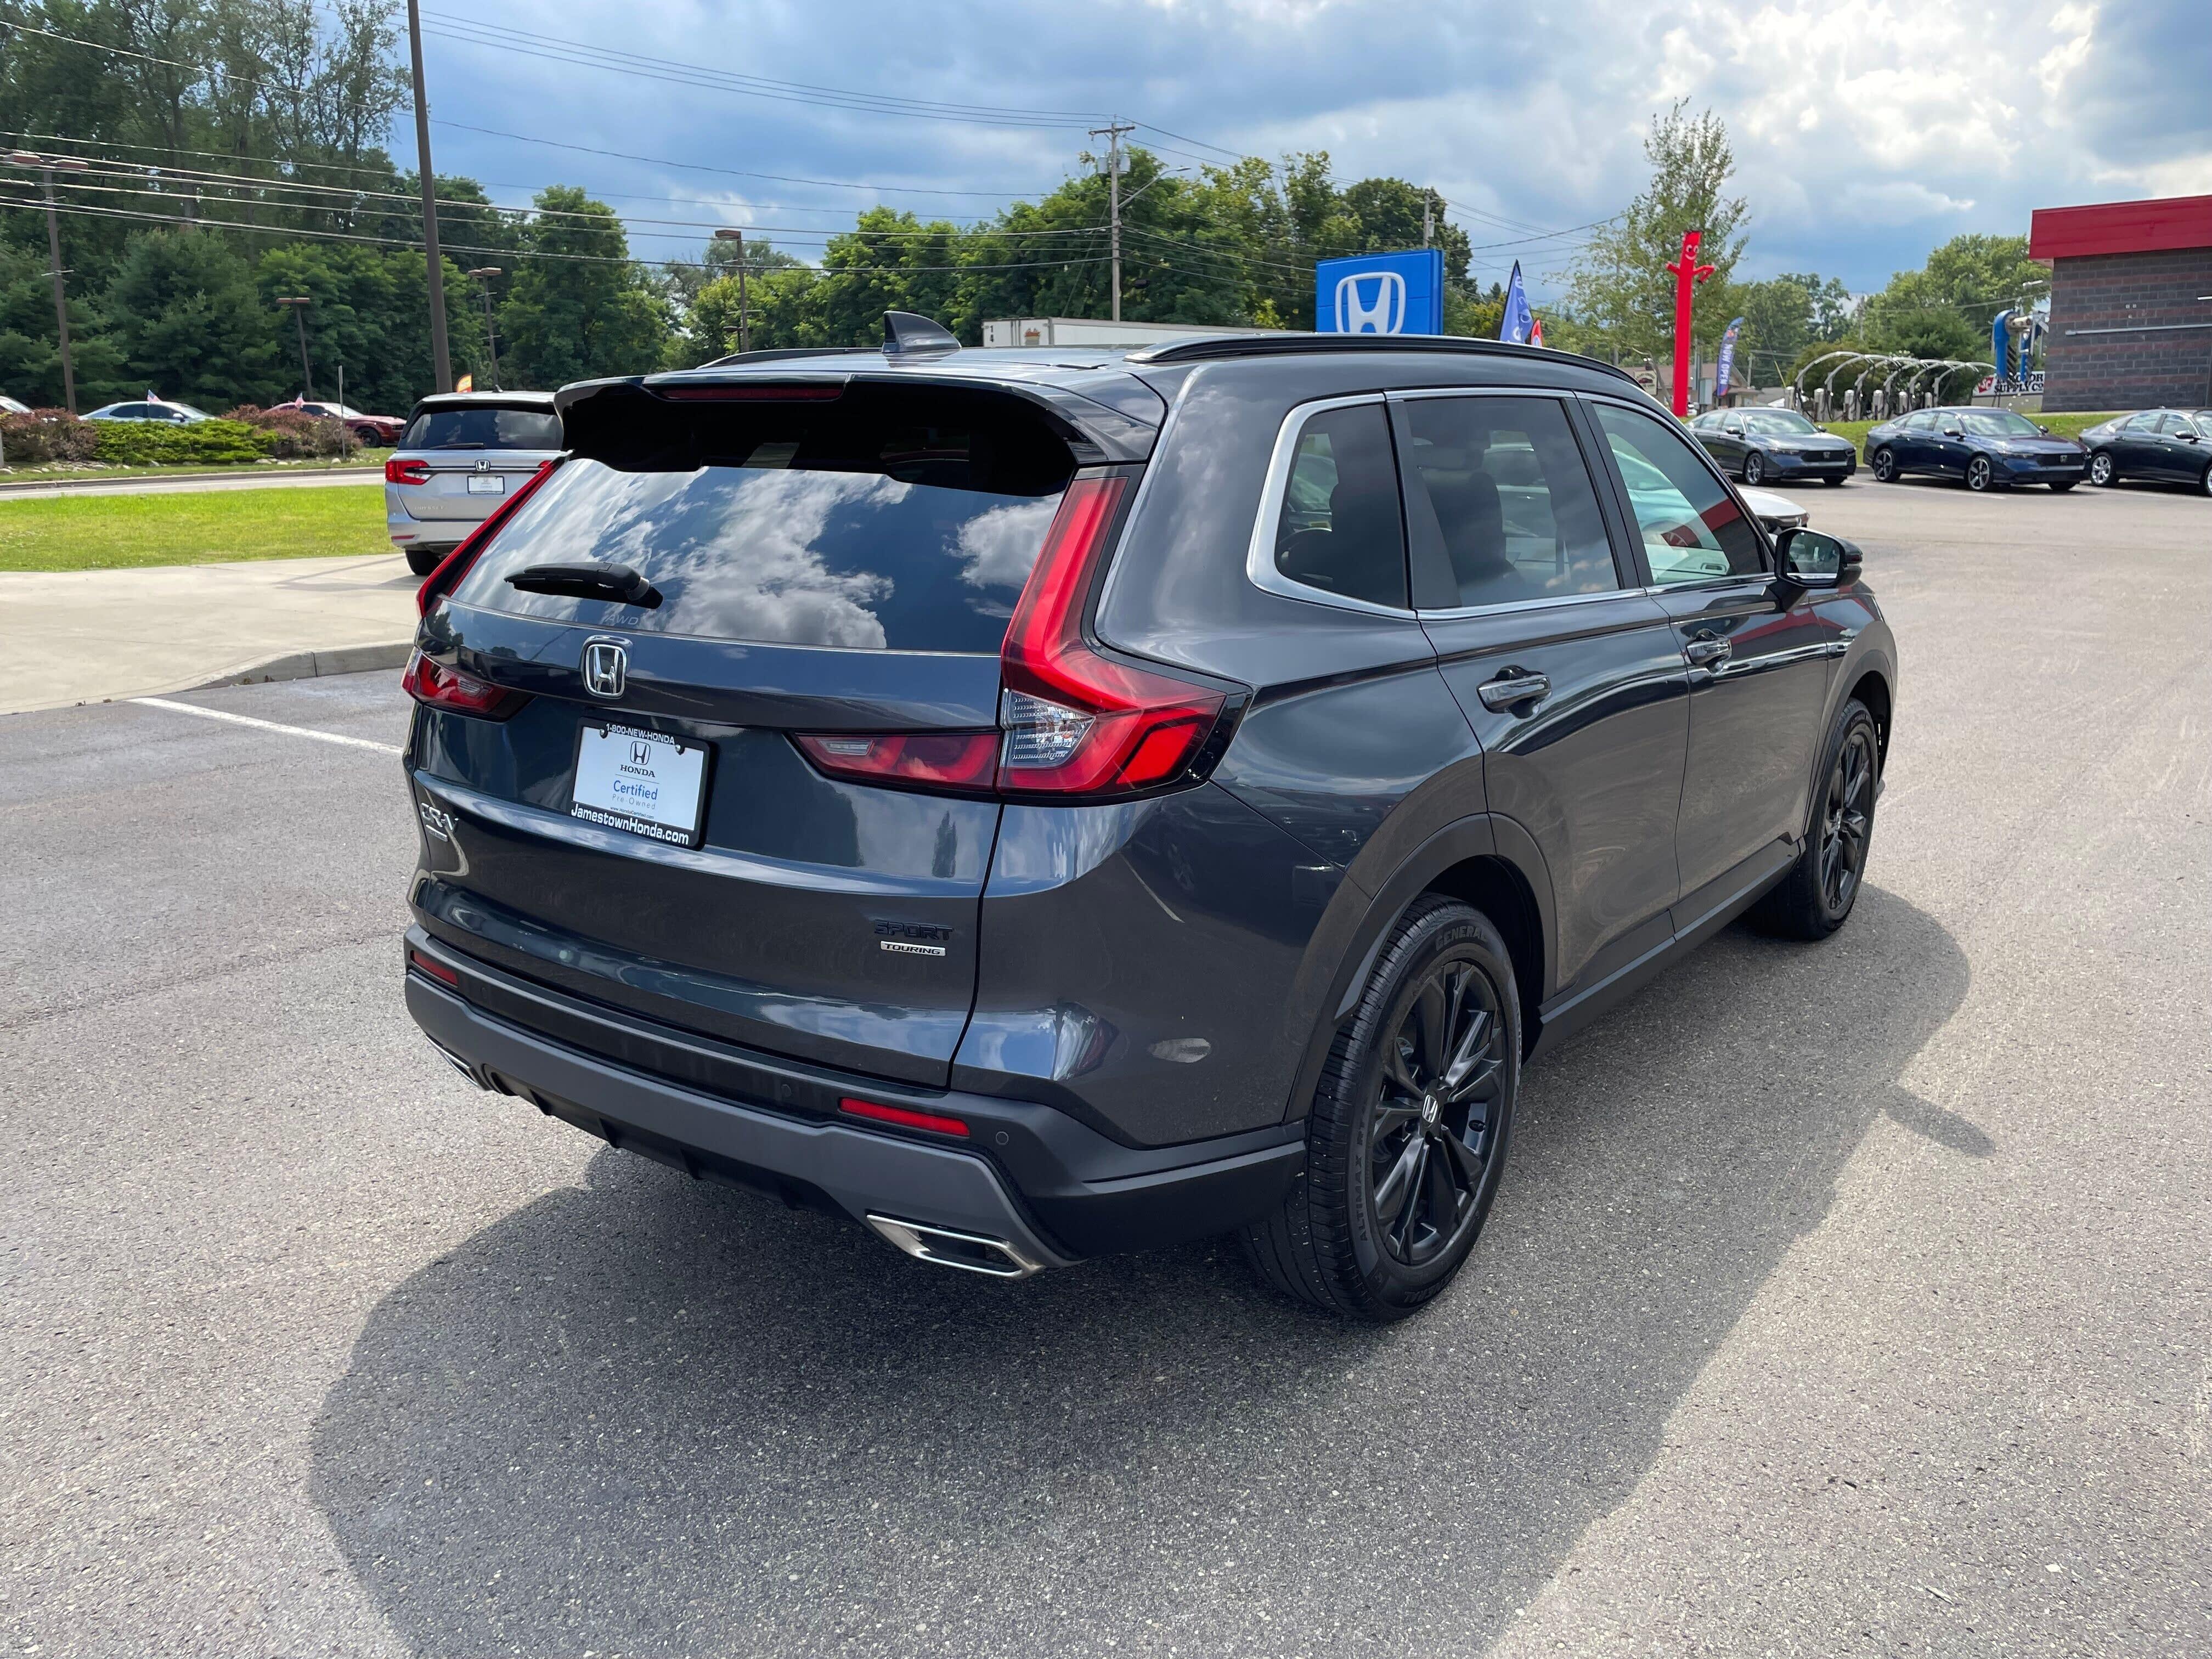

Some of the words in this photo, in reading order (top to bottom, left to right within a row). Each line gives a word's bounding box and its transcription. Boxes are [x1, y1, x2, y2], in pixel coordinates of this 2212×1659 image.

[1719, 363, 1730, 385] OPEN
[605, 614, 639, 625] AWD
[606, 723, 675, 746] 1-800-NEW-HONDA
[620, 764, 656, 778] HONDA
[613, 780, 658, 800] Certified
[571, 803, 689, 845] JamestownHonda.com
[874, 919, 953, 940] SPORT
[885, 943, 940, 955] TOURING
